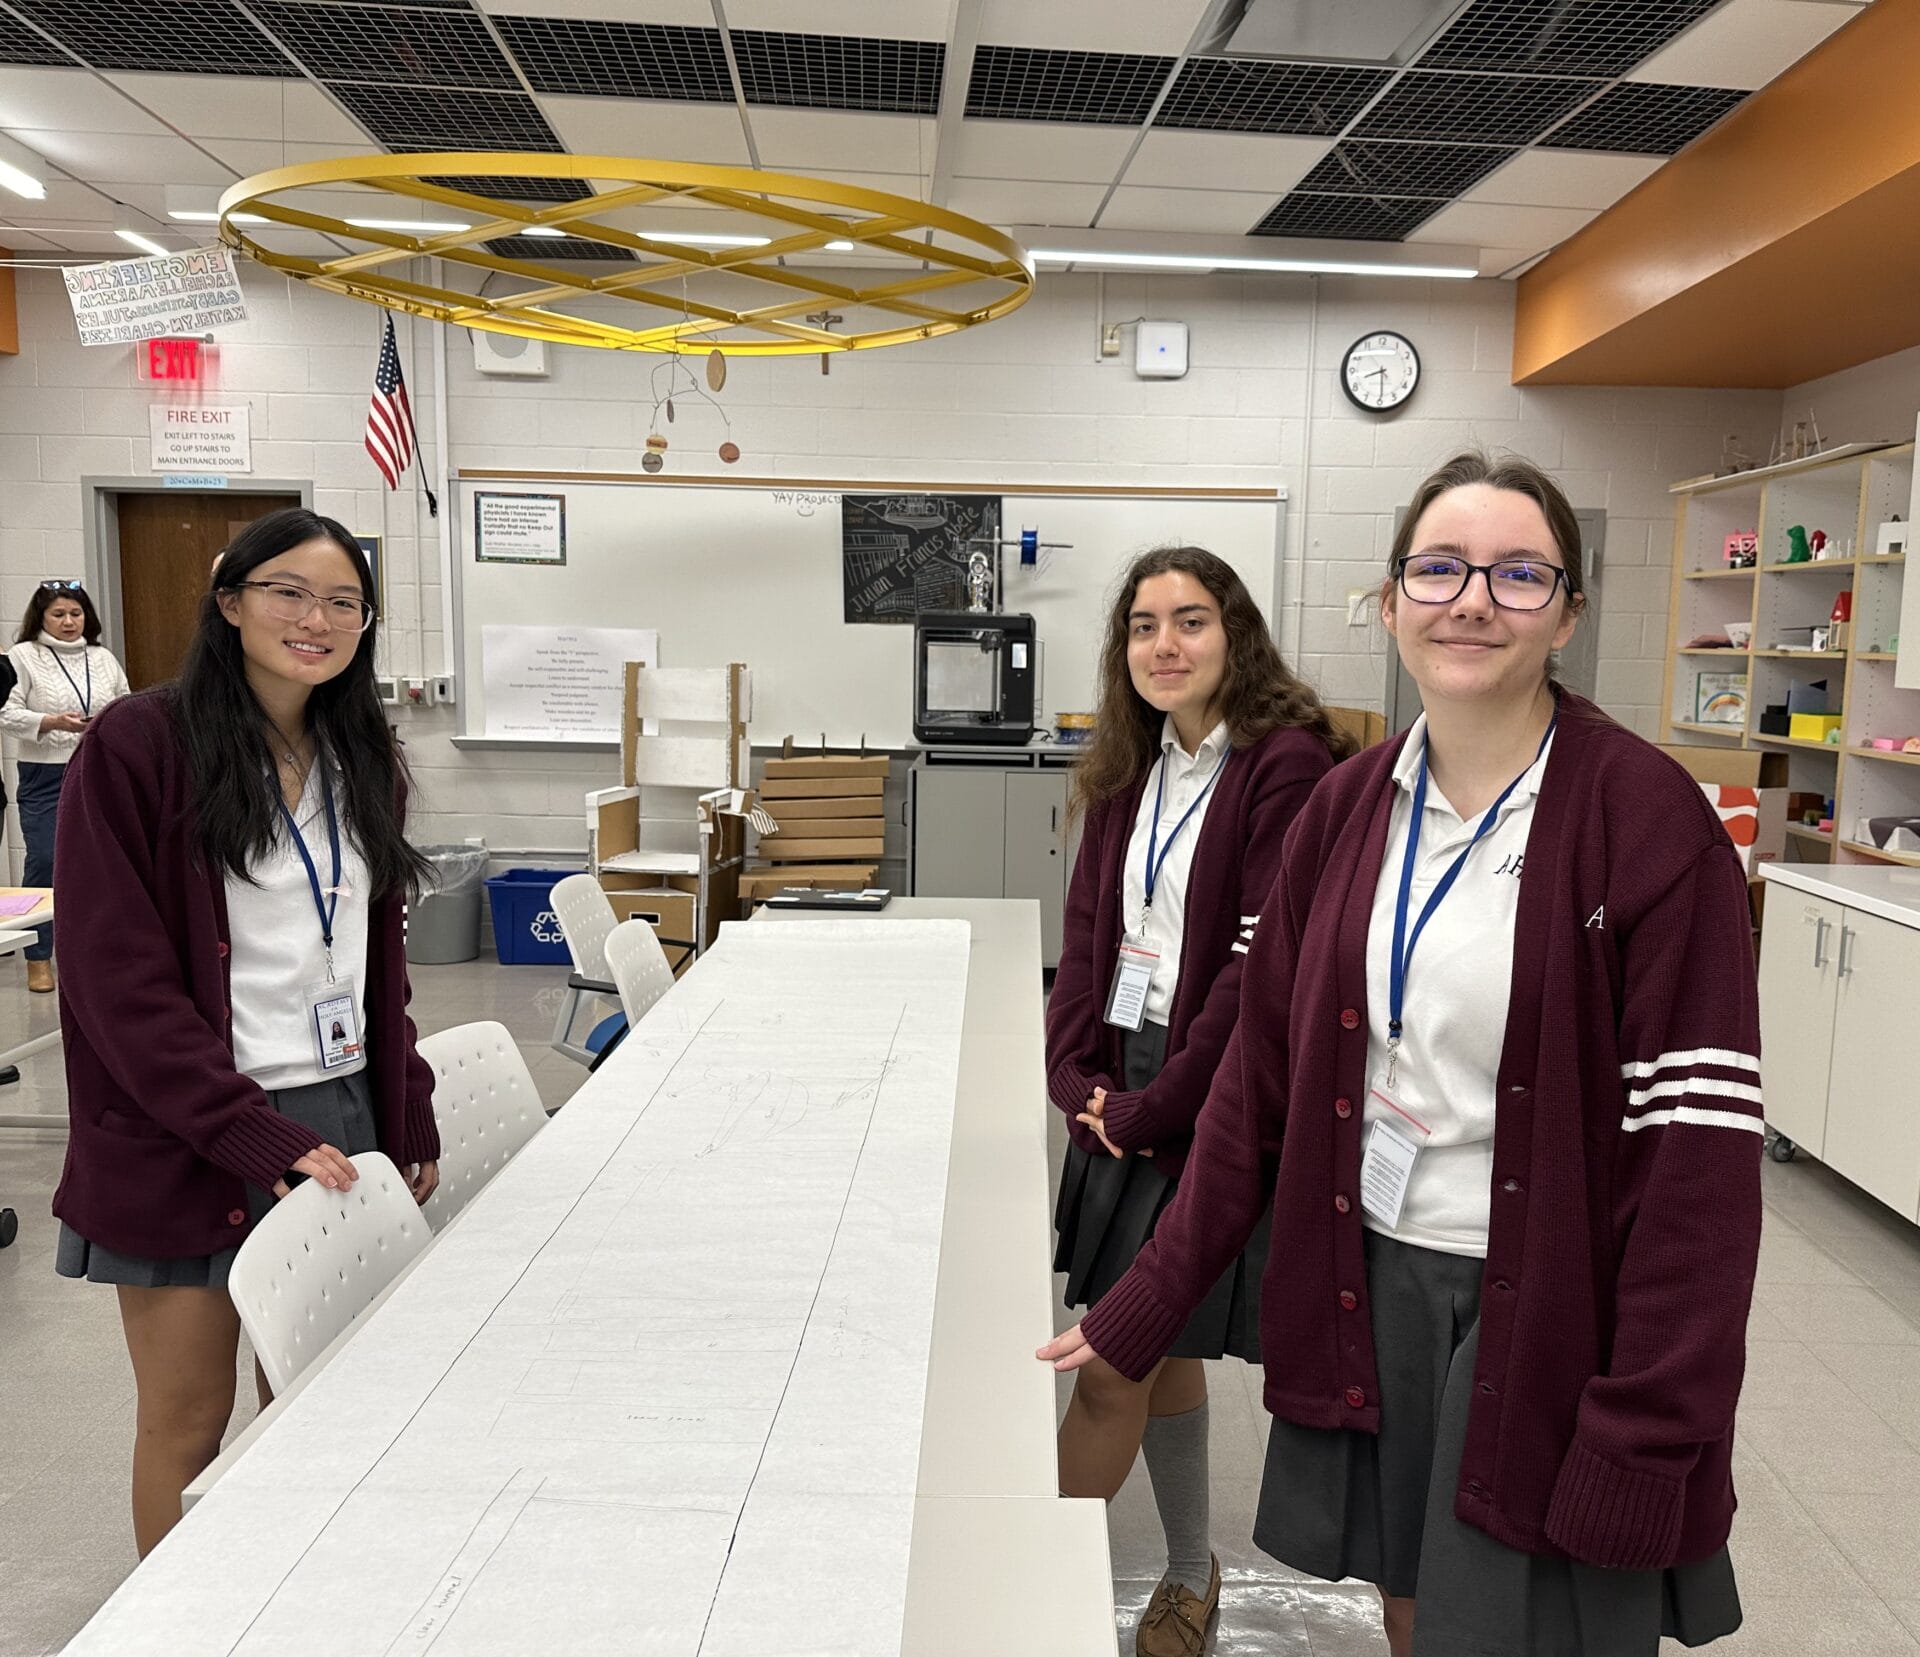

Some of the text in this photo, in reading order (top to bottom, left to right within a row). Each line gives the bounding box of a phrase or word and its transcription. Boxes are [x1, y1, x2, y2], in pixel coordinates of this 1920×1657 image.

[1379, 337, 1387, 345] 12
[149, 340, 198, 379] EXIT
[1352, 382, 1358, 391] 8
[1392, 392, 1397, 401] 5
[167, 411, 231, 423] FIRE EXIT
[182, 432, 198, 440] LEFT
[211, 433, 235, 441] STAIRS
[170, 444, 181, 452] GO
[183, 444, 193, 452] UP
[180, 457, 217, 465] ENTRANCE
[219, 458, 244, 466] DOORS
[773, 492, 841, 504] YAY PROJECTS
[852, 506, 979, 613] Julian Francis Abele
[1584, 904, 1604, 929] A
